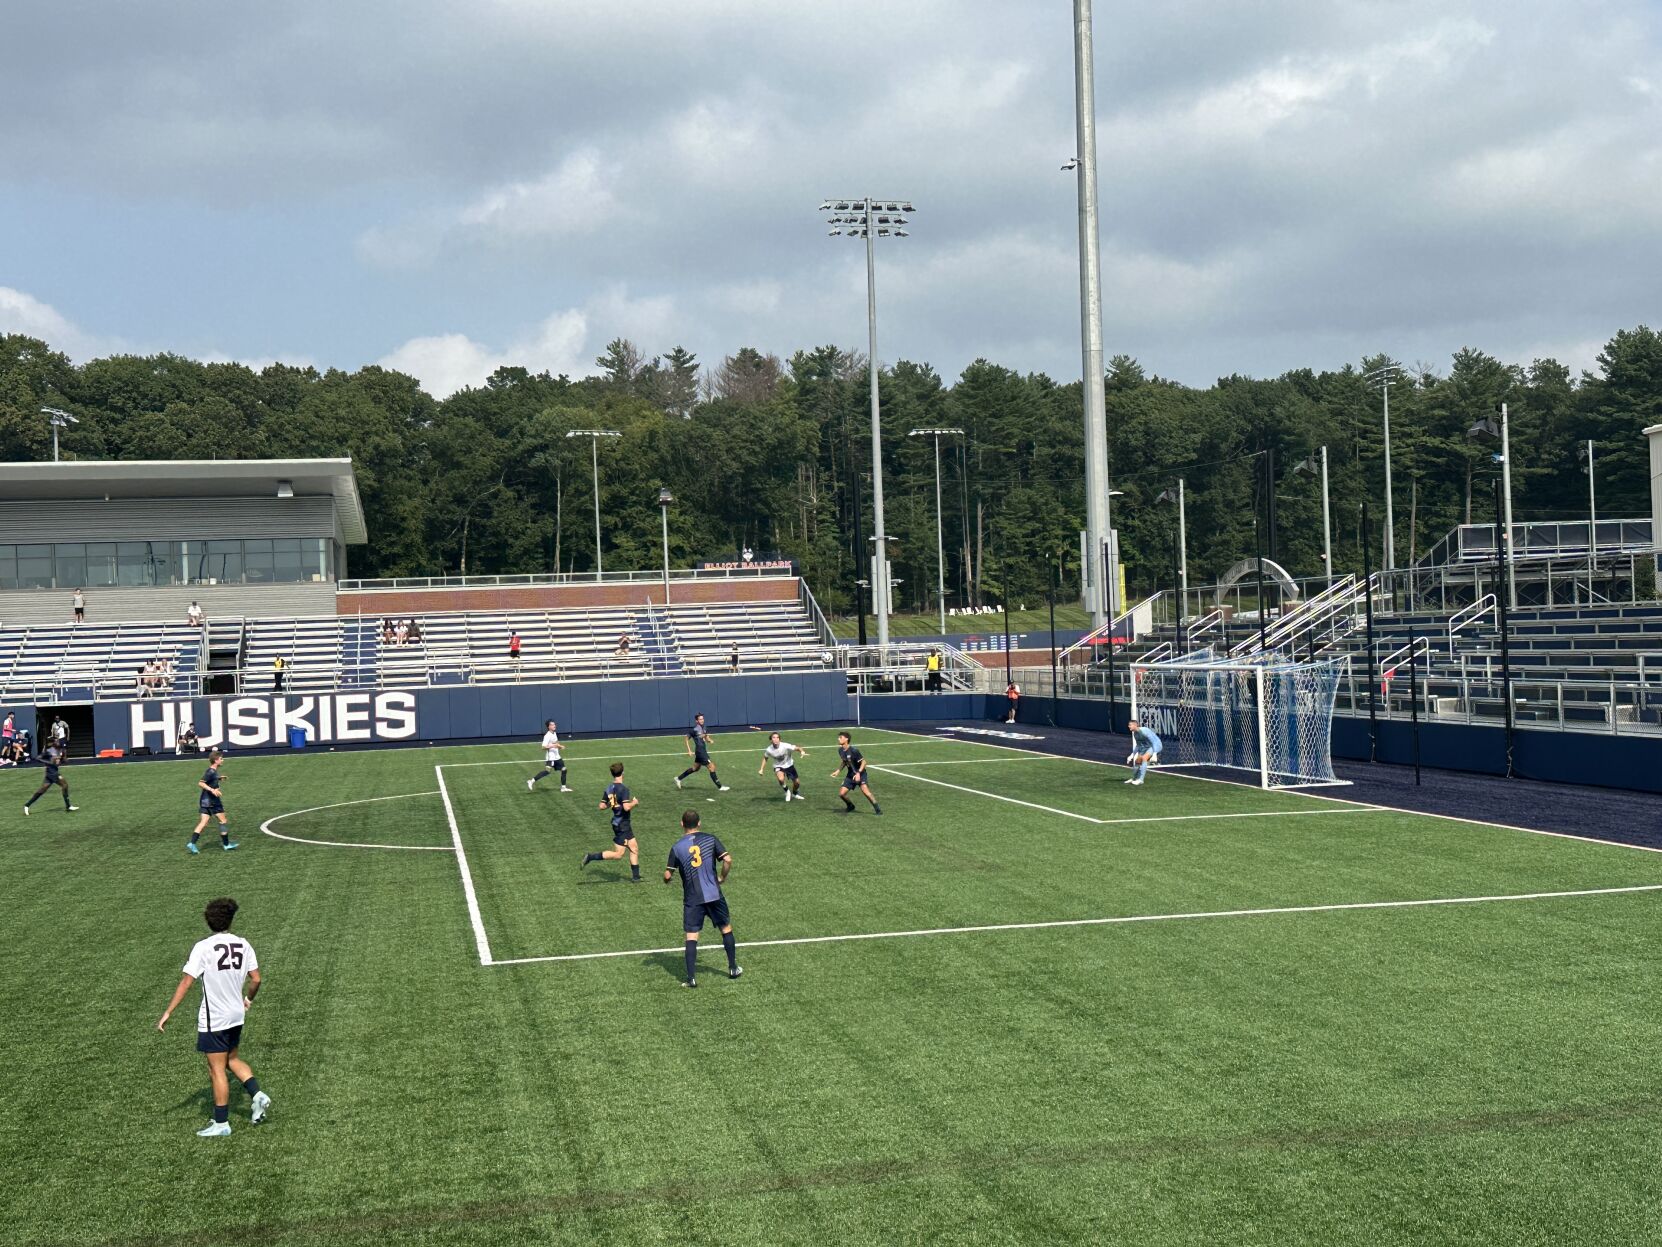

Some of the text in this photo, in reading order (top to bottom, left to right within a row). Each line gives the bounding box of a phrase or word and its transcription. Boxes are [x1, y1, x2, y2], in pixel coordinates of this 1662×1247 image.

[741, 560, 792, 569] BALLPARK
[130, 691, 417, 749] HUSKIES
[688, 845, 703, 868] 3
[213, 943, 243, 971] 25
